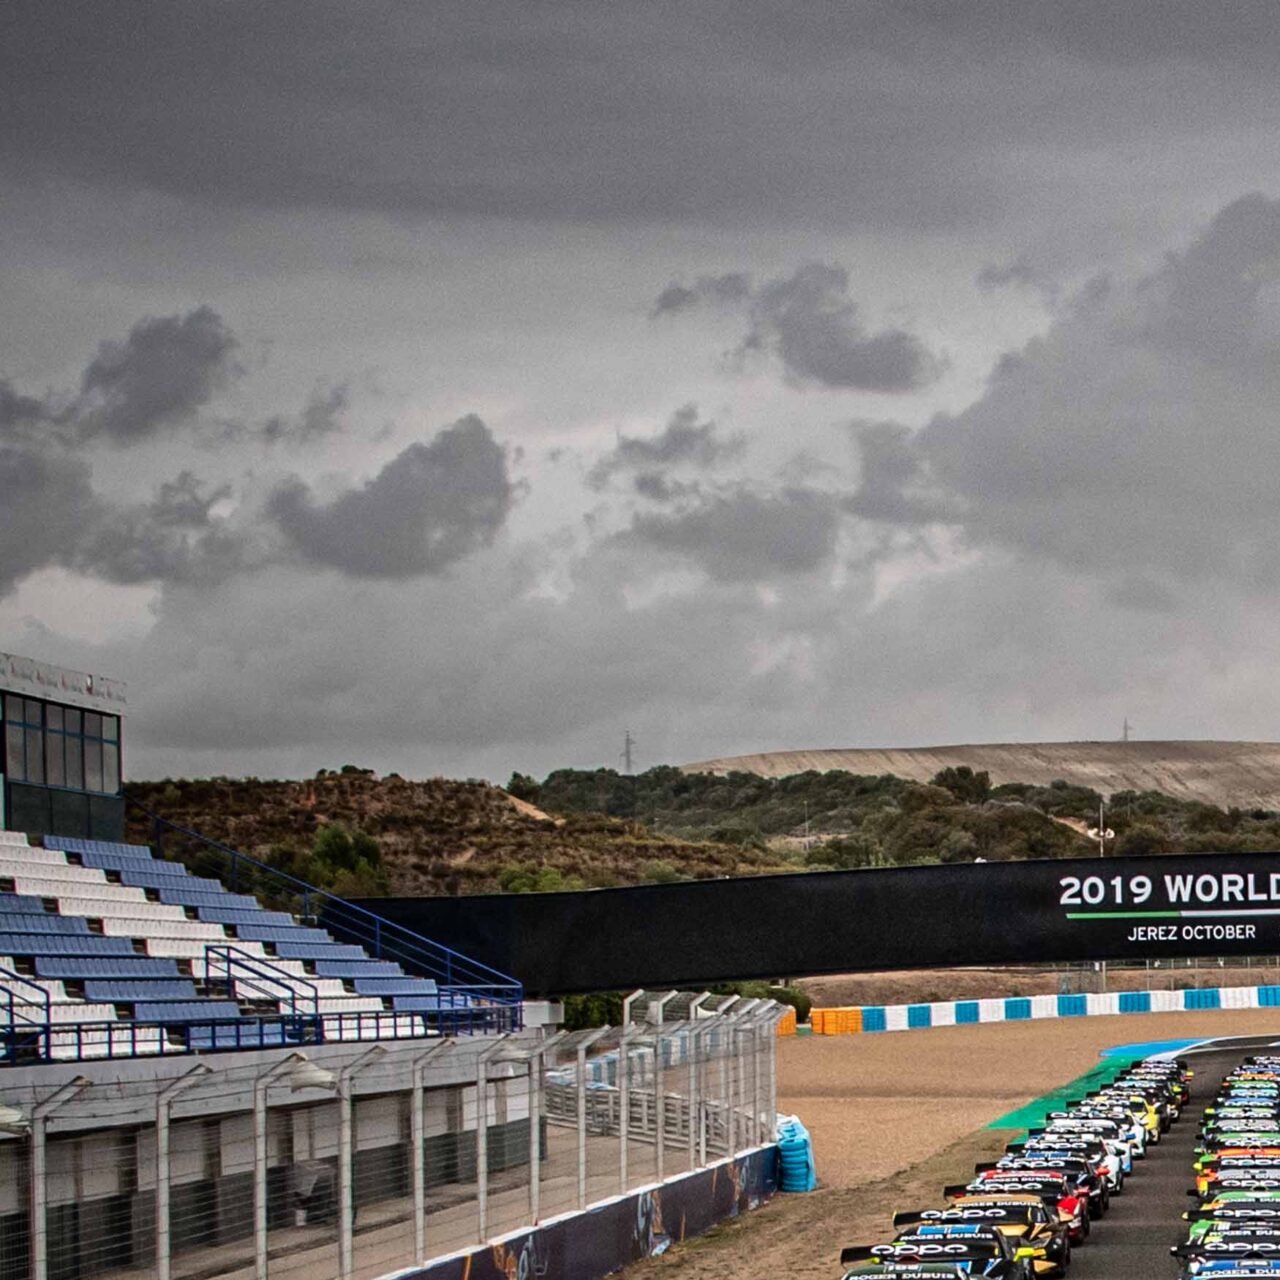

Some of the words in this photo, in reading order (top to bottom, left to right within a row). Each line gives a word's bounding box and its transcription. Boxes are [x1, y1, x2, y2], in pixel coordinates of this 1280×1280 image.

[1059, 875, 1152, 904] 2019
[1128, 926, 1177, 941] JEREZ
[1182, 924, 1256, 940] OCTOBER
[871, 1244, 968, 1256] oppo
[849, 1273, 896, 1280] ROGER
